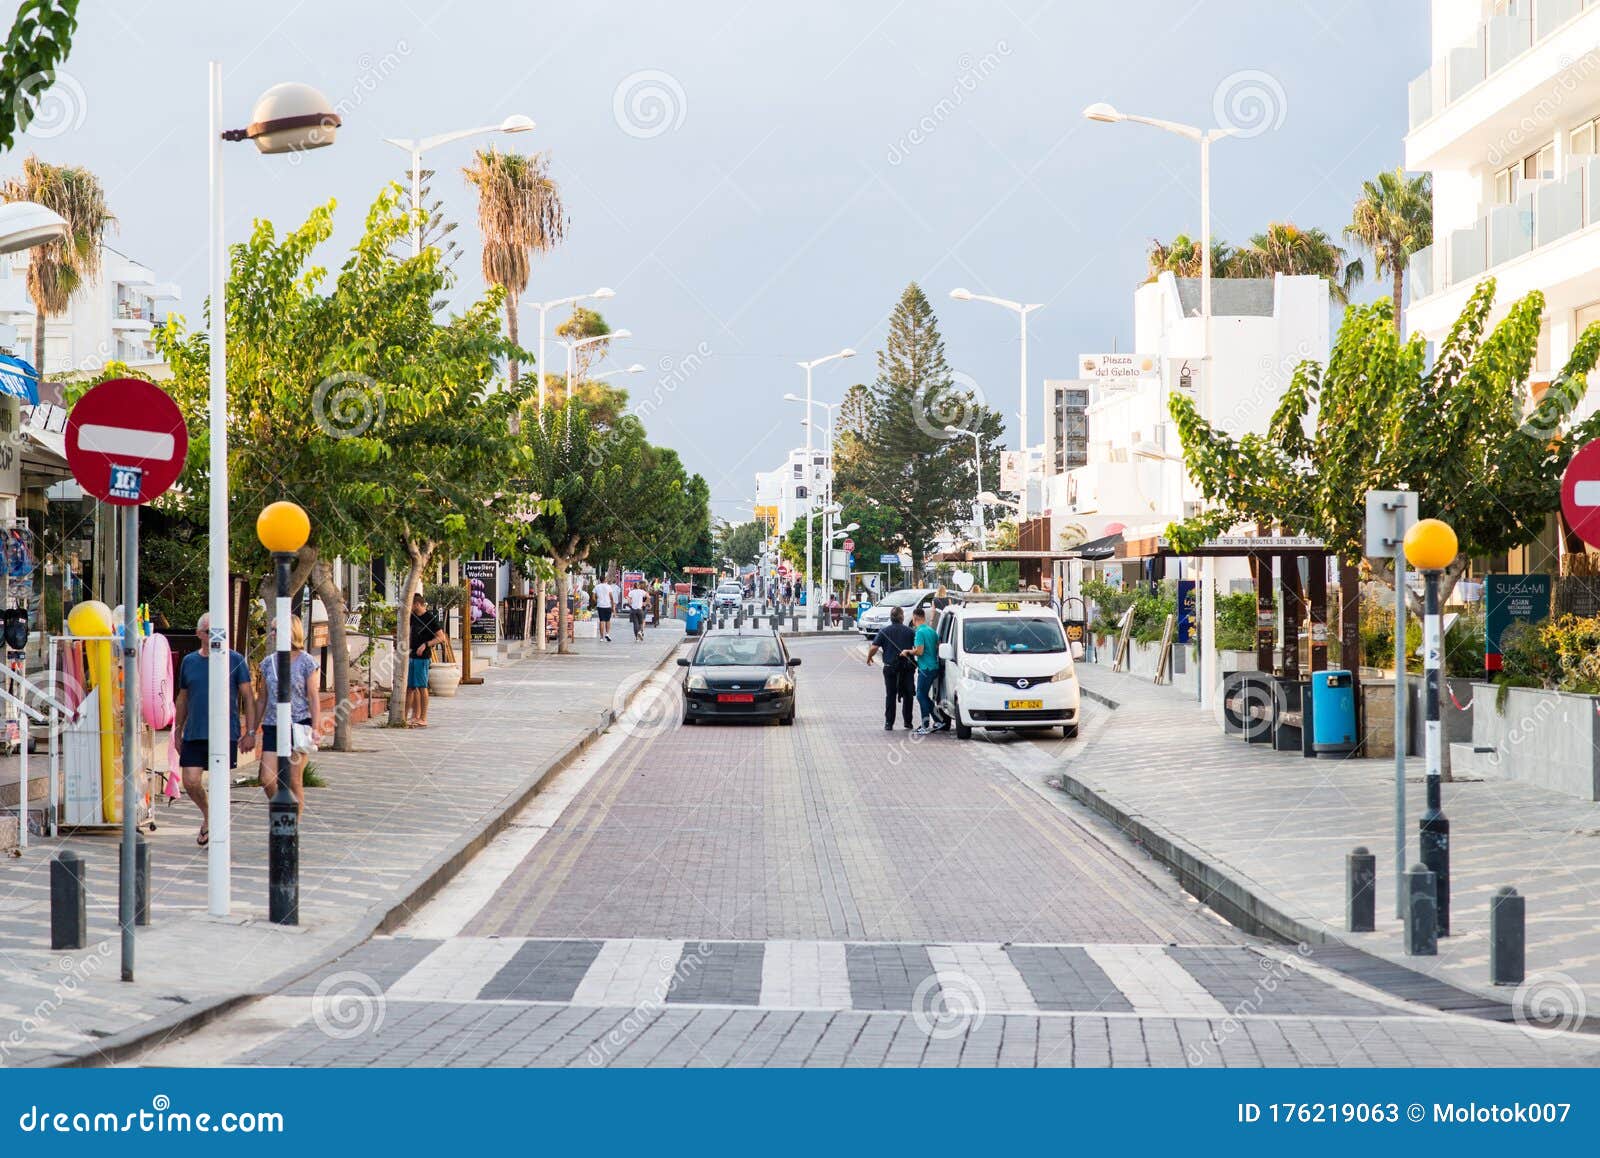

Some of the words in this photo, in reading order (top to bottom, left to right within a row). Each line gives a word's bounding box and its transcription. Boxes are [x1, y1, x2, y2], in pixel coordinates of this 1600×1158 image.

[1103, 355, 1132, 365] Piazza
[1095, 368, 1109, 377] del
[1111, 368, 1140, 377] Gelato
[466, 564, 495, 573] Jewellery
